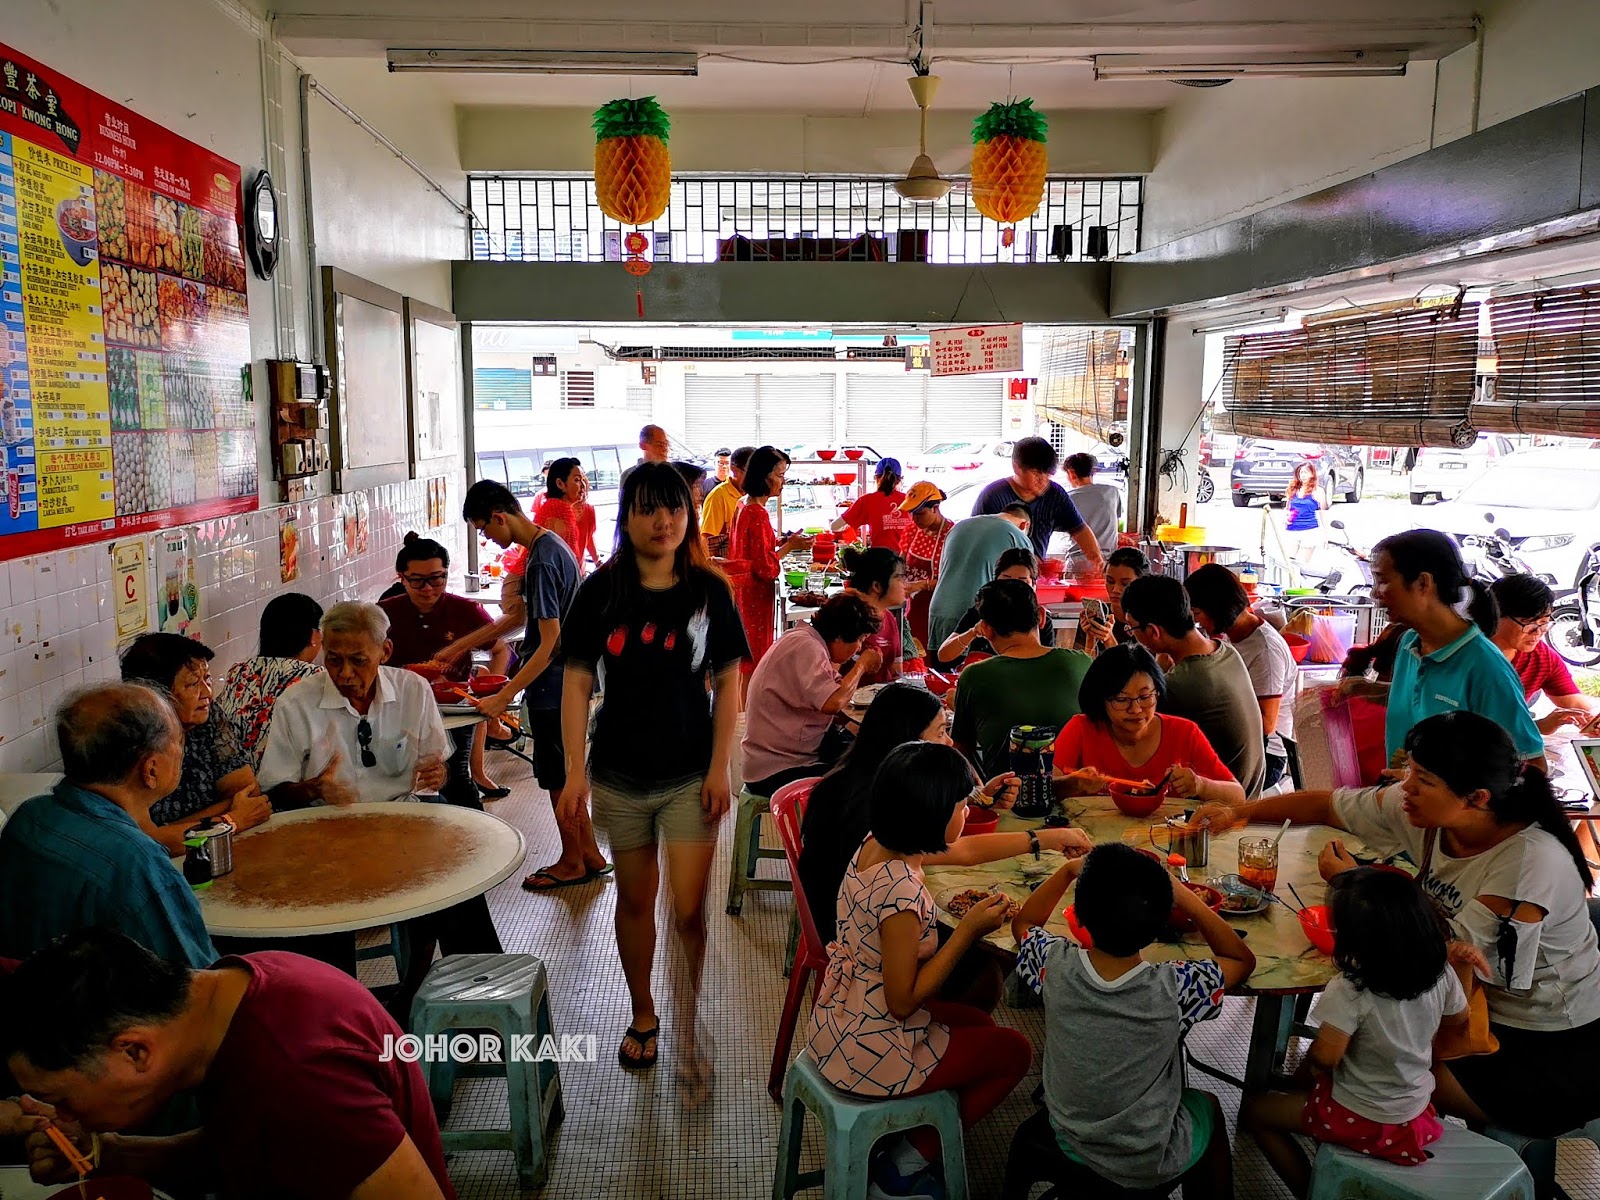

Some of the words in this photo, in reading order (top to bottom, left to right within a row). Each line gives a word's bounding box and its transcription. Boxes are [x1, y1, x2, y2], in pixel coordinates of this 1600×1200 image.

[21, 105, 52, 130] KWONG
[55, 121, 78, 142] HONG
[52, 157, 70, 172] PRICE
[70, 164, 82, 176] LIST
[126, 574, 135, 599] C
